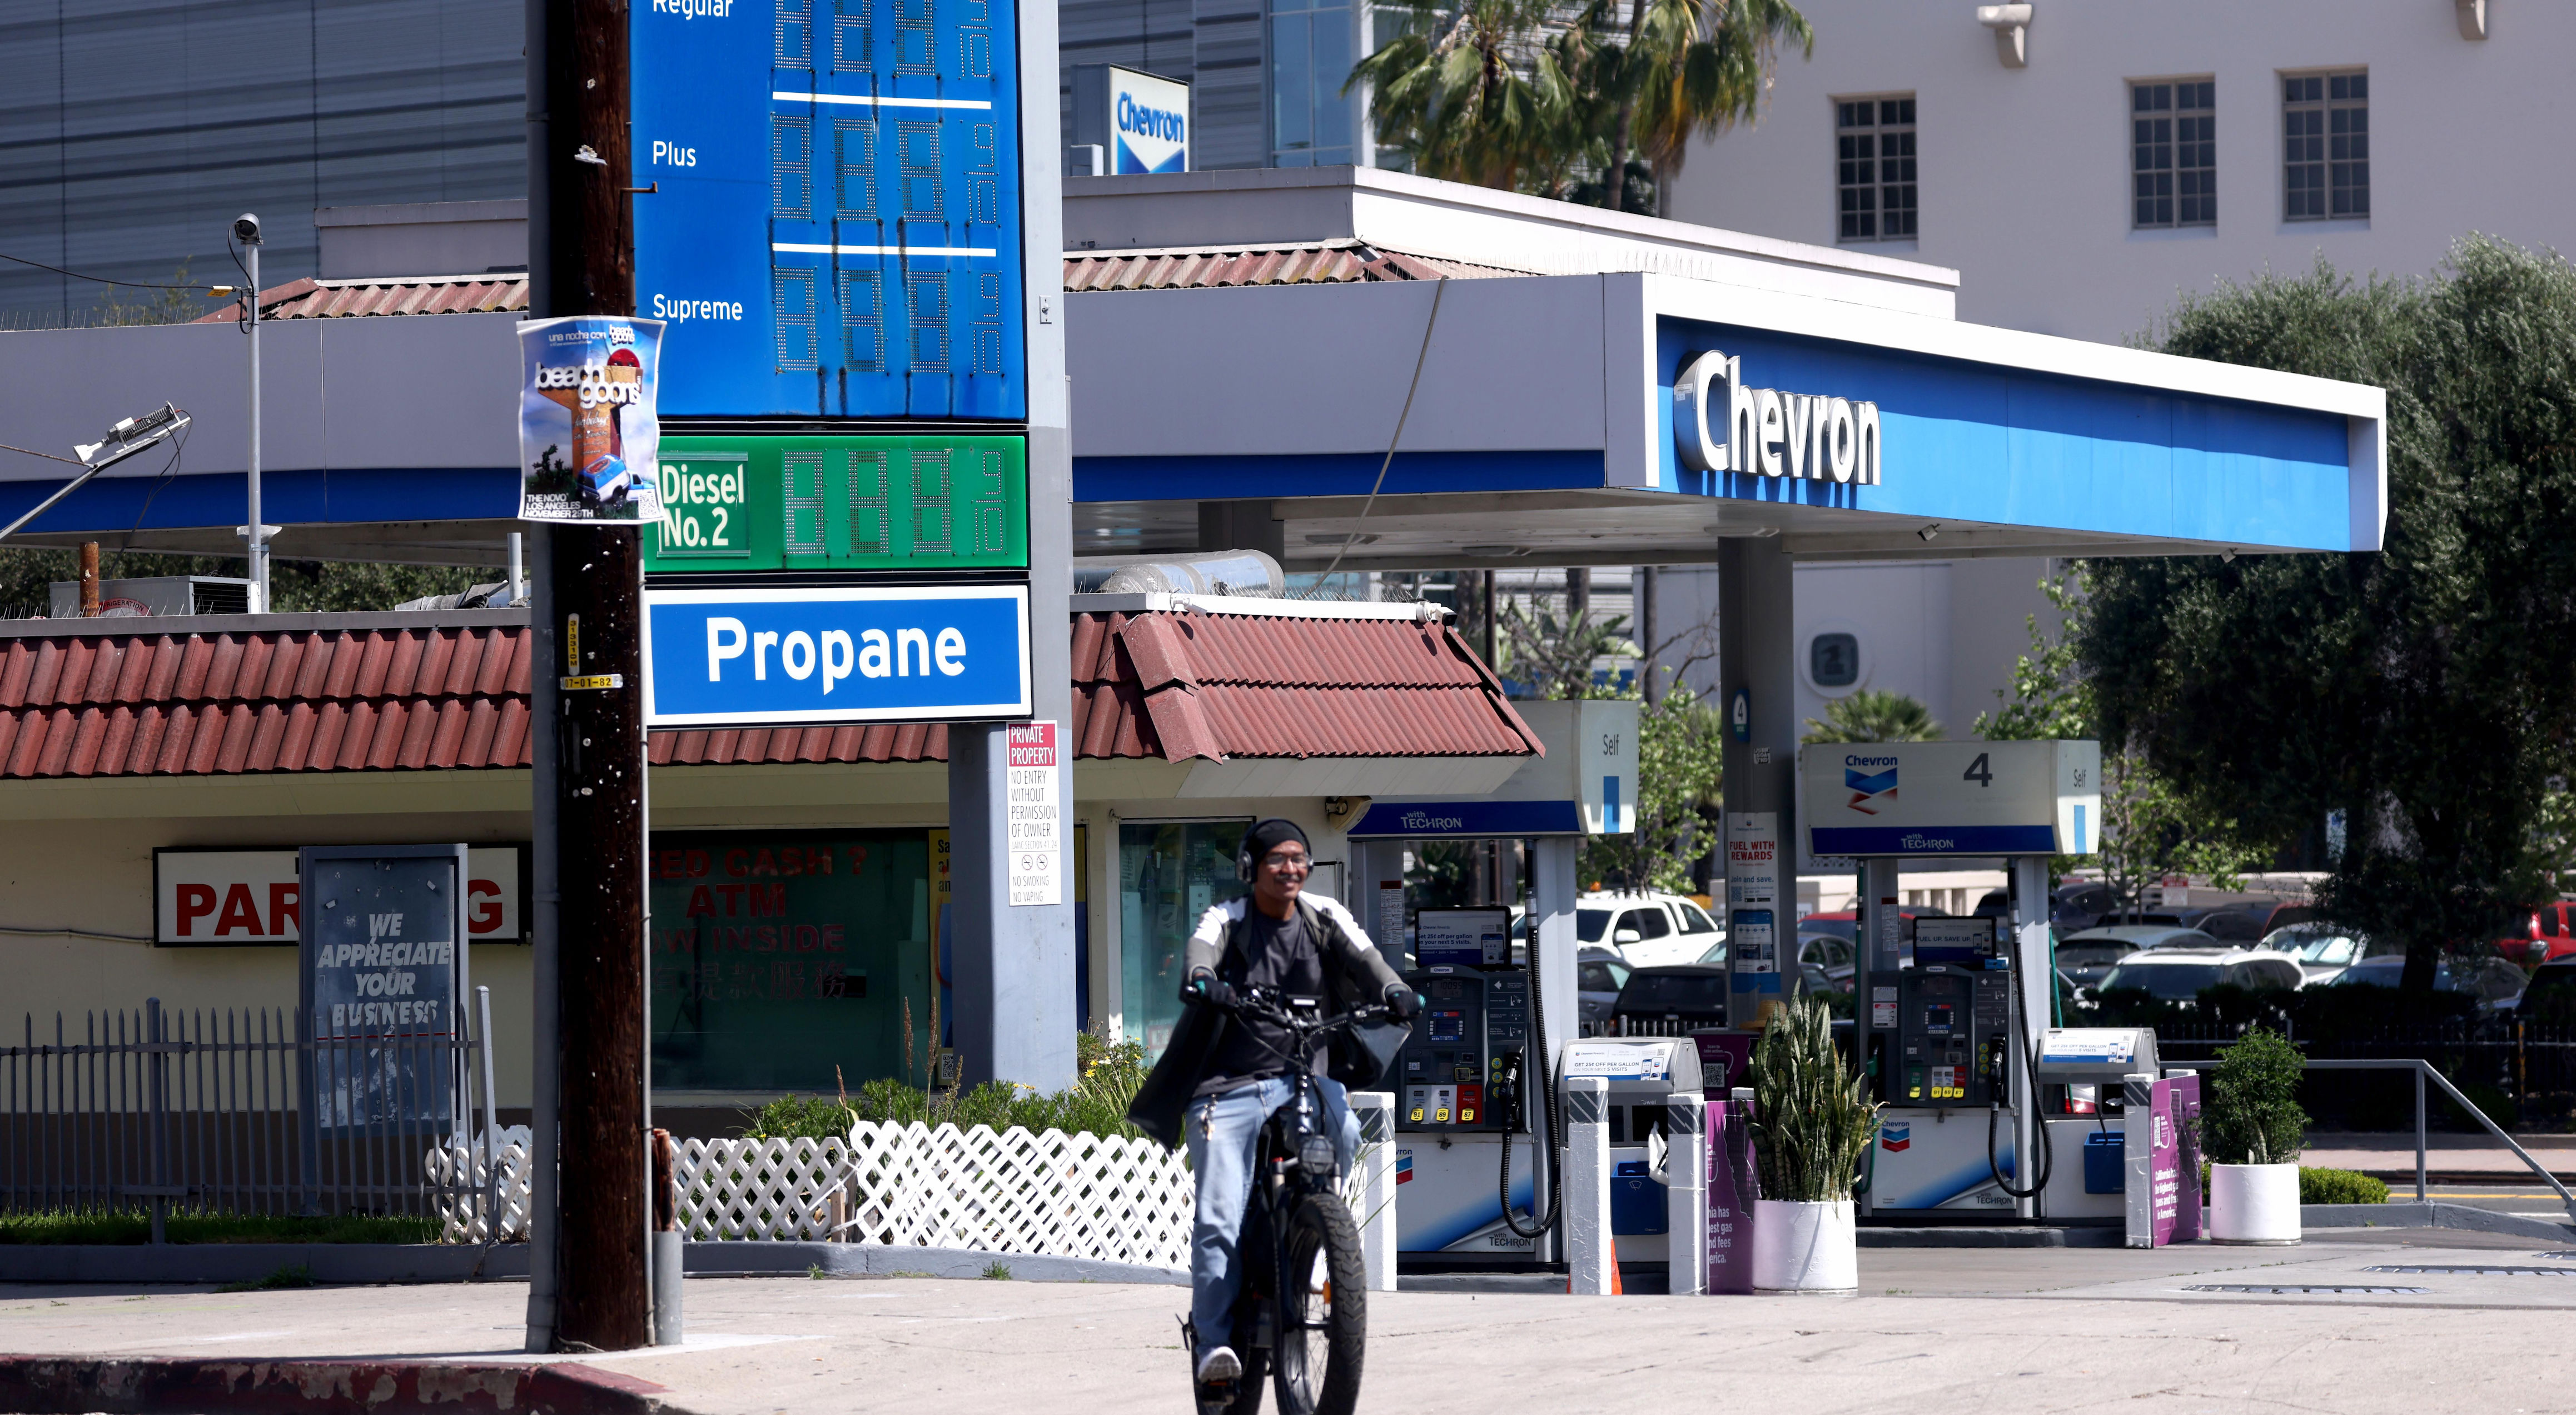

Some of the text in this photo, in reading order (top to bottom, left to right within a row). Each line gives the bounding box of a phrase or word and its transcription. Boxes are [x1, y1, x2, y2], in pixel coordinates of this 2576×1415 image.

[1117, 91, 1185, 143] Chevron
[653, 140, 697, 167] Plus
[653, 293, 743, 323] Supreme
[549, 330, 606, 342] una noche con
[535, 358, 605, 388] beach
[579, 376, 640, 410] goons
[1674, 350, 1881, 485] Chevron
[662, 464, 744, 505] Diesel
[528, 493, 568, 503] THE NOVO
[543, 501, 580, 510] ANGELES
[572, 509, 593, 517] 29TH
[664, 506, 729, 547] No. 2
[707, 617, 966, 696] Propane
[565, 677, 611, 687] 07-01-82
[1738, 702, 1743, 720] 4
[1011, 726, 1044, 743] PRIVATE
[1603, 734, 1619, 755] Self
[1011, 747, 1053, 764] PROPERTY
[1845, 754, 1898, 766] Chevron
[1011, 770, 1046, 784] NO ENTRY
[1963, 753, 1993, 787] 4
[2073, 769, 2086, 788] Self
[1011, 788, 1044, 802] WITHOUT
[1012, 805, 1056, 820] PERMISSION
[1012, 823, 1051, 838] OF OWNER
[1400, 816, 1462, 830] TECHRON
[1012, 840, 1057, 850] LAMC SECTION 41.24
[1730, 840, 1774, 850] FUEL WITH
[1901, 838, 1954, 850] TECHRON
[650, 845, 867, 879] ED CASH ?
[1732, 851, 1773, 860] REWARDS
[1013, 875, 1050, 886] NO SMOKING
[686, 883, 786, 919] ATM
[1013, 891, 1043, 903] NO VAPING
[176, 879, 503, 936] PARG
[369, 913, 403, 937] WE
[713, 924, 846, 954] INSIDE
[317, 941, 451, 968] APPRECIATE
[355, 973, 416, 997] YOUR
[332, 1000, 438, 1027] BUSINESS
[2155, 1168, 2171, 1181] California
[1976, 1196, 2012, 1205] TECHRON
[1718, 1205, 1729, 1218] has
[1721, 1223, 1733, 1235] gas
[1489, 1237, 1531, 1248] TECHRON
[1718, 1235, 1731, 1248] fees
[1709, 1252, 1727, 1264] erica.
